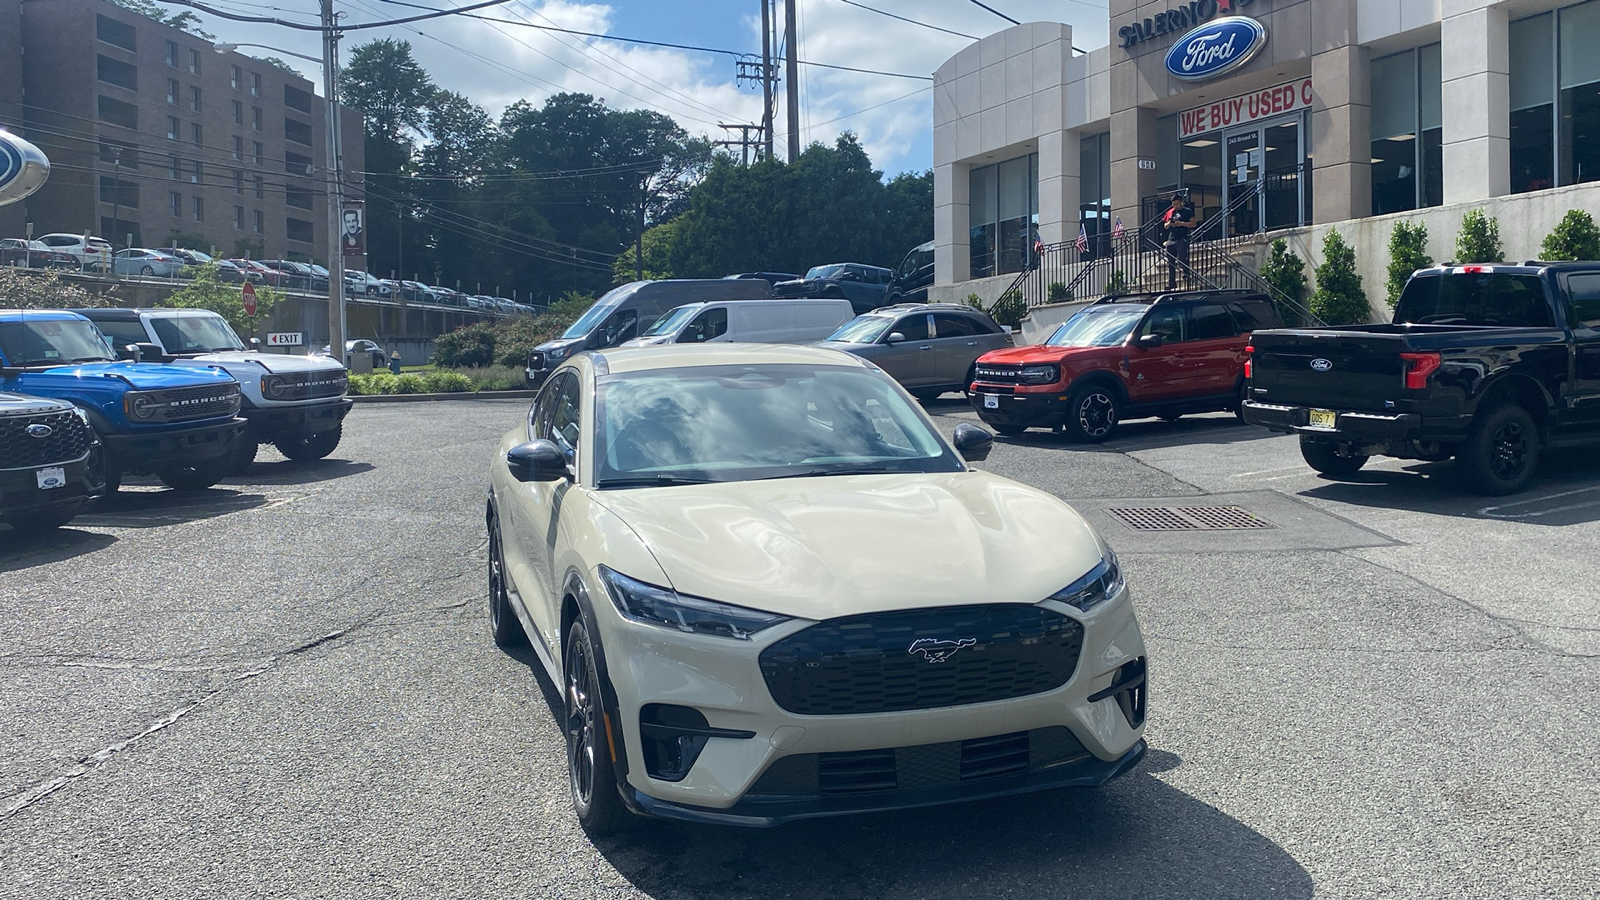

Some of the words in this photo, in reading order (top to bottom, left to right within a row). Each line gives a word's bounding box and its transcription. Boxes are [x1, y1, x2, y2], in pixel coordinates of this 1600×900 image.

[1182, 31, 1237, 71] Ford
[1181, 108, 1206, 135] WE
[1211, 98, 1243, 128] BUY
[1248, 85, 1295, 119] USED
[1237, 134, 1251, 142] Broad
[243, 292, 256, 306] STOP
[279, 334, 298, 344] EXIT
[1314, 360, 1329, 369] Ford
[296, 379, 338, 387] BRONCO
[170, 395, 226, 407] BRONCO
